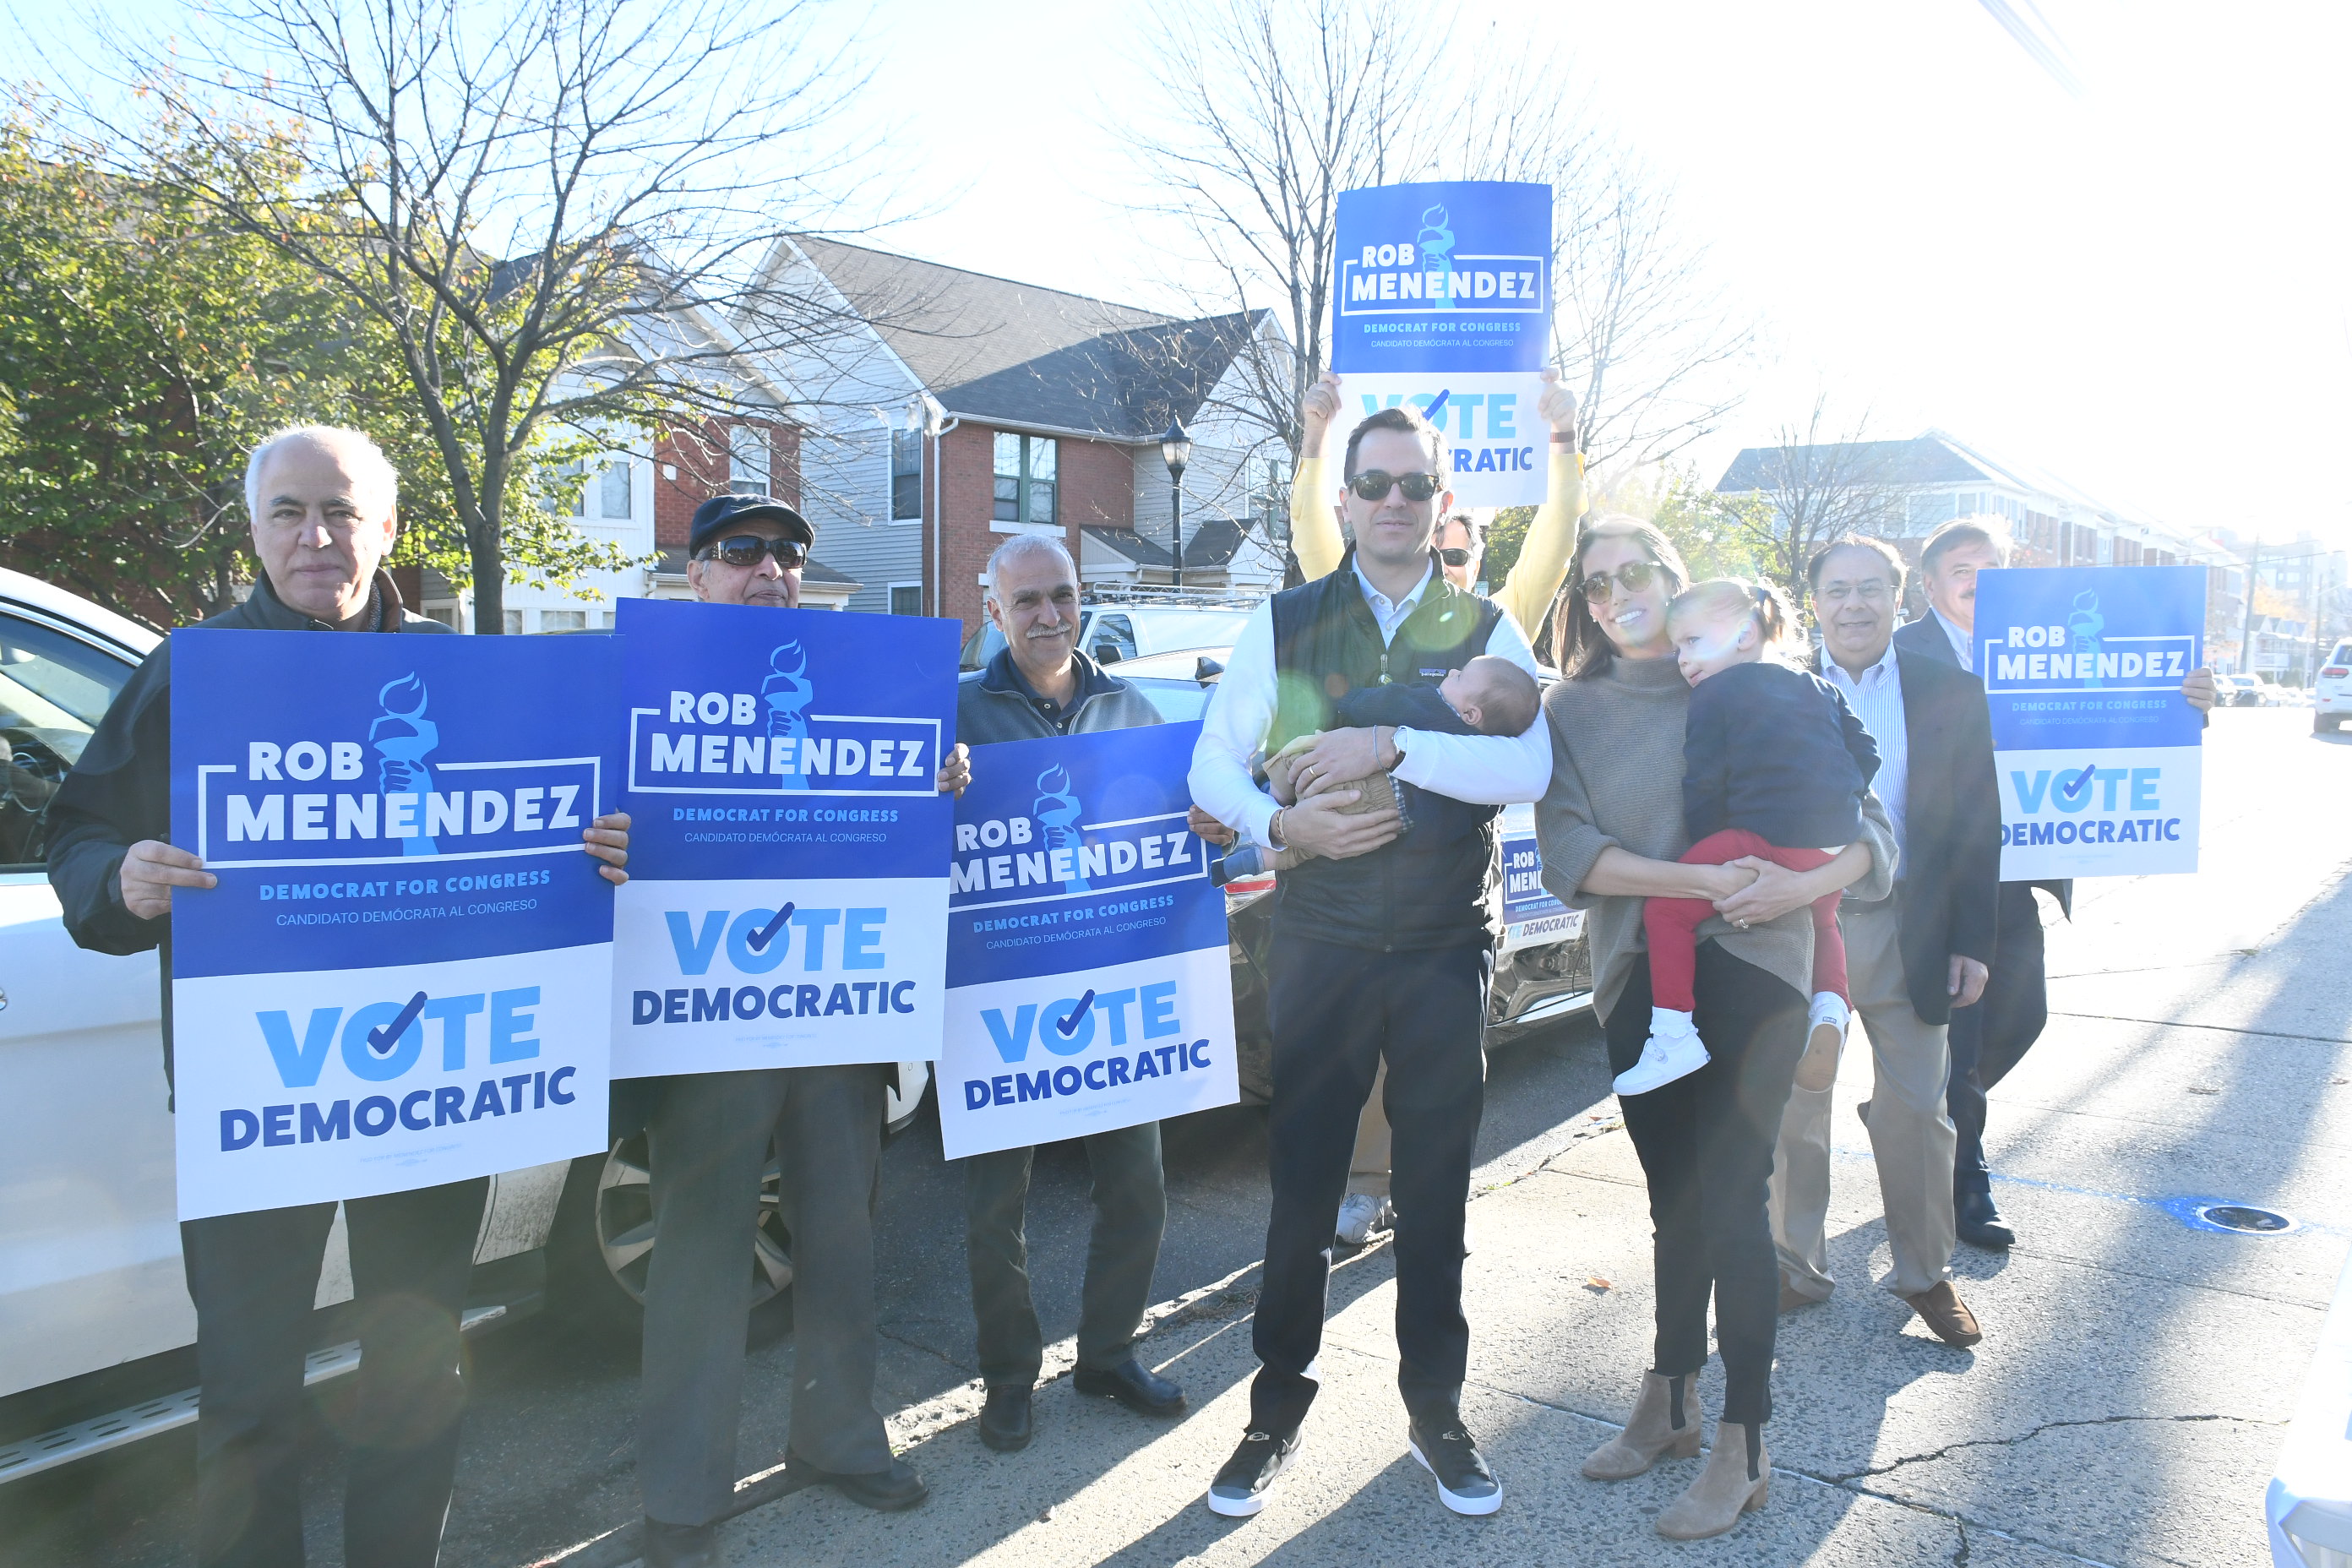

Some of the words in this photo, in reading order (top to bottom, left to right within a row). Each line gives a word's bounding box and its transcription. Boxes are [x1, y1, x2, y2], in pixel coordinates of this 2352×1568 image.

[1363, 243, 1414, 268] ROB
[1352, 271, 1535, 301] MENENDEZ
[1364, 324, 1428, 333] DEMOCRAT
[1432, 324, 1456, 332] FOR
[1460, 324, 1520, 332] CONGRESS
[1413, 338, 1461, 347] DEMÓCRATA
[1449, 447, 1533, 471] RATIC
[2008, 626, 2066, 648] ROB
[1997, 651, 2184, 679] MENENDEZ
[670, 691, 756, 725] ROB
[2012, 702, 2077, 711] DEMOCRAT
[2080, 702, 2103, 710] FOR
[2107, 700, 2167, 710] CONGRESS
[248, 741, 363, 781] ROB
[651, 733, 924, 776] MENENDEZ
[2011, 768, 2161, 814] VOTE
[226, 785, 580, 841] MENENDEZ
[673, 808, 770, 821] DEMOCRAT
[776, 809, 808, 822] FOR
[814, 809, 898, 822] CONGRESS
[684, 832, 746, 843] CANDIDATO
[749, 830, 814, 843] DEMÓCRATA
[815, 833, 828, 842] AL
[830, 832, 886, 842] CONGRESO
[956, 817, 1032, 852] ROB
[2001, 819, 2180, 846] DEMOCRATIC
[950, 831, 1190, 893] MENENDEZ
[1514, 852, 1534, 868] ROB
[259, 881, 389, 901] DEMOCRAT
[395, 877, 438, 896] FOR
[445, 870, 550, 891] CONGRESS
[276, 912, 359, 926] CANDIDATO
[363, 905, 446, 923] DEMÓCRATA
[449, 904, 464, 917] AL
[467, 900, 536, 916] CONGRESO
[973, 912, 1059, 933] DEMOCRAT
[1064, 906, 1094, 921] FOR
[1098, 895, 1173, 918] CONGRESS
[1516, 904, 1538, 912] DEMOCRAT
[665, 907, 886, 975] VOTE
[986, 937, 1042, 950] CANDIDATO
[1043, 927, 1102, 943] DEMÓCRATA
[1103, 926, 1114, 934] AL
[1116, 917, 1166, 933] CONGRESO
[1522, 915, 1579, 936] DEMOCRATIC
[633, 981, 915, 1025] DEMOCRATIC
[256, 986, 541, 1088] VOTE
[980, 980, 1180, 1063] VOTE
[964, 1039, 1211, 1110] DEMOCRATIC
[220, 1066, 575, 1152] DEMOCRATIC
